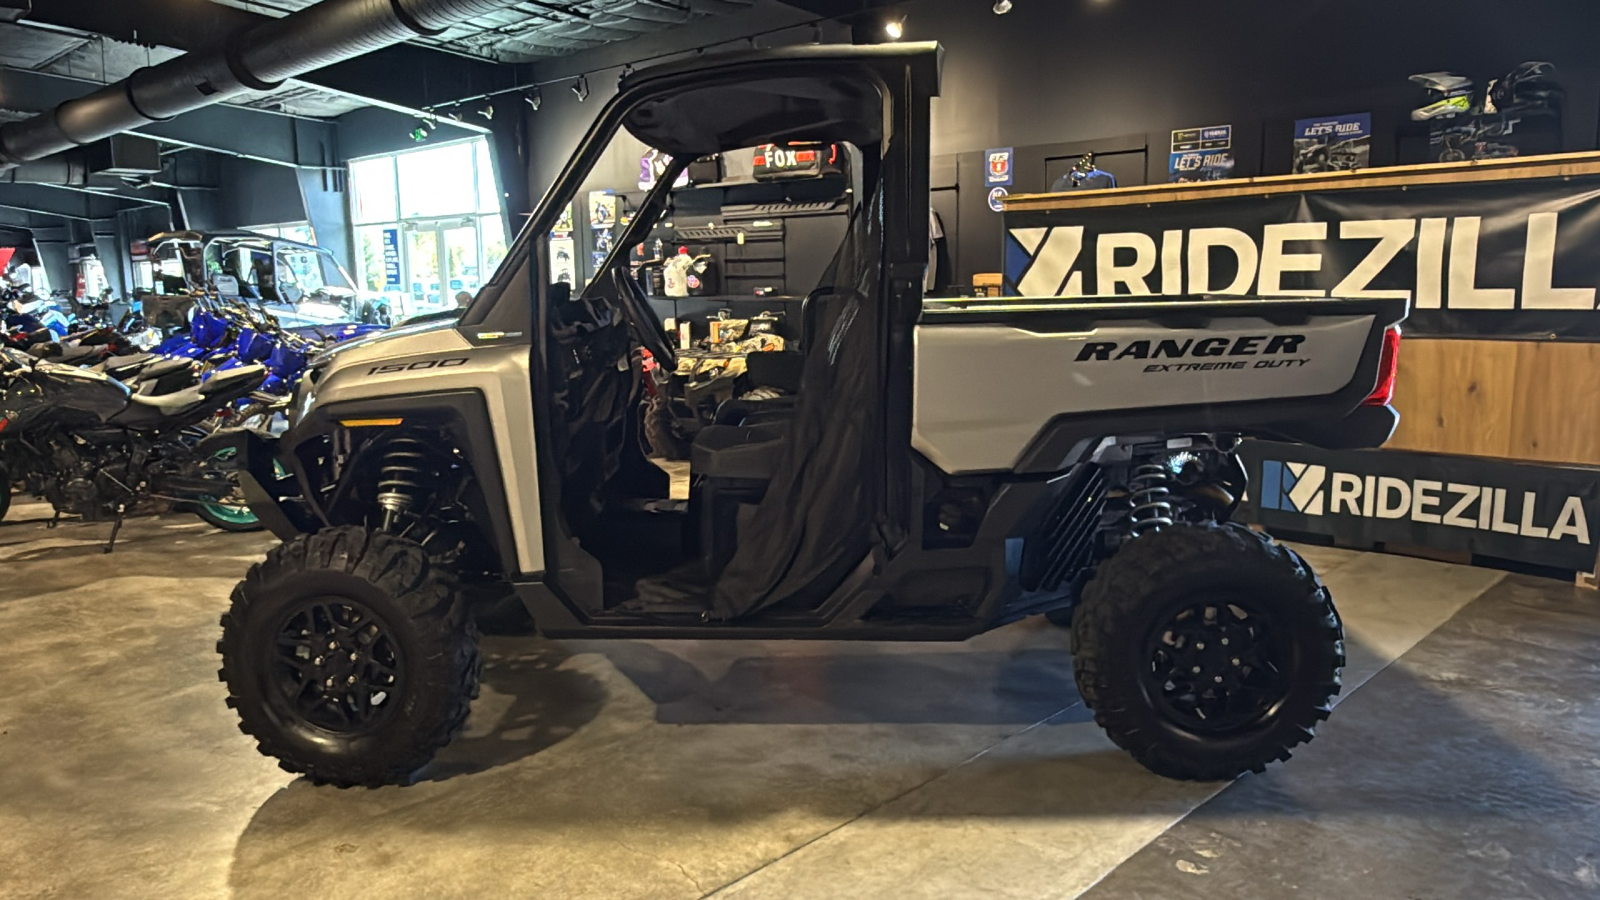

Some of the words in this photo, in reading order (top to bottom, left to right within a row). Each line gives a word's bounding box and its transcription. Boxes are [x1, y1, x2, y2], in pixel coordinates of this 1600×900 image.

[1304, 126, 1333, 136] LET'S
[1335, 123, 1361, 133] RIDE
[764, 150, 798, 168] FOX
[1174, 155, 1203, 170] LET'S
[1203, 153, 1229, 166] RIDE
[1097, 211, 1600, 310] RIDEZILL
[1073, 334, 1306, 362] RANGER
[367, 358, 470, 376] 1500
[1143, 361, 1248, 373] EXTREME
[1253, 358, 1311, 369] DUTY
[1330, 472, 1591, 545] RIDEZILLA
